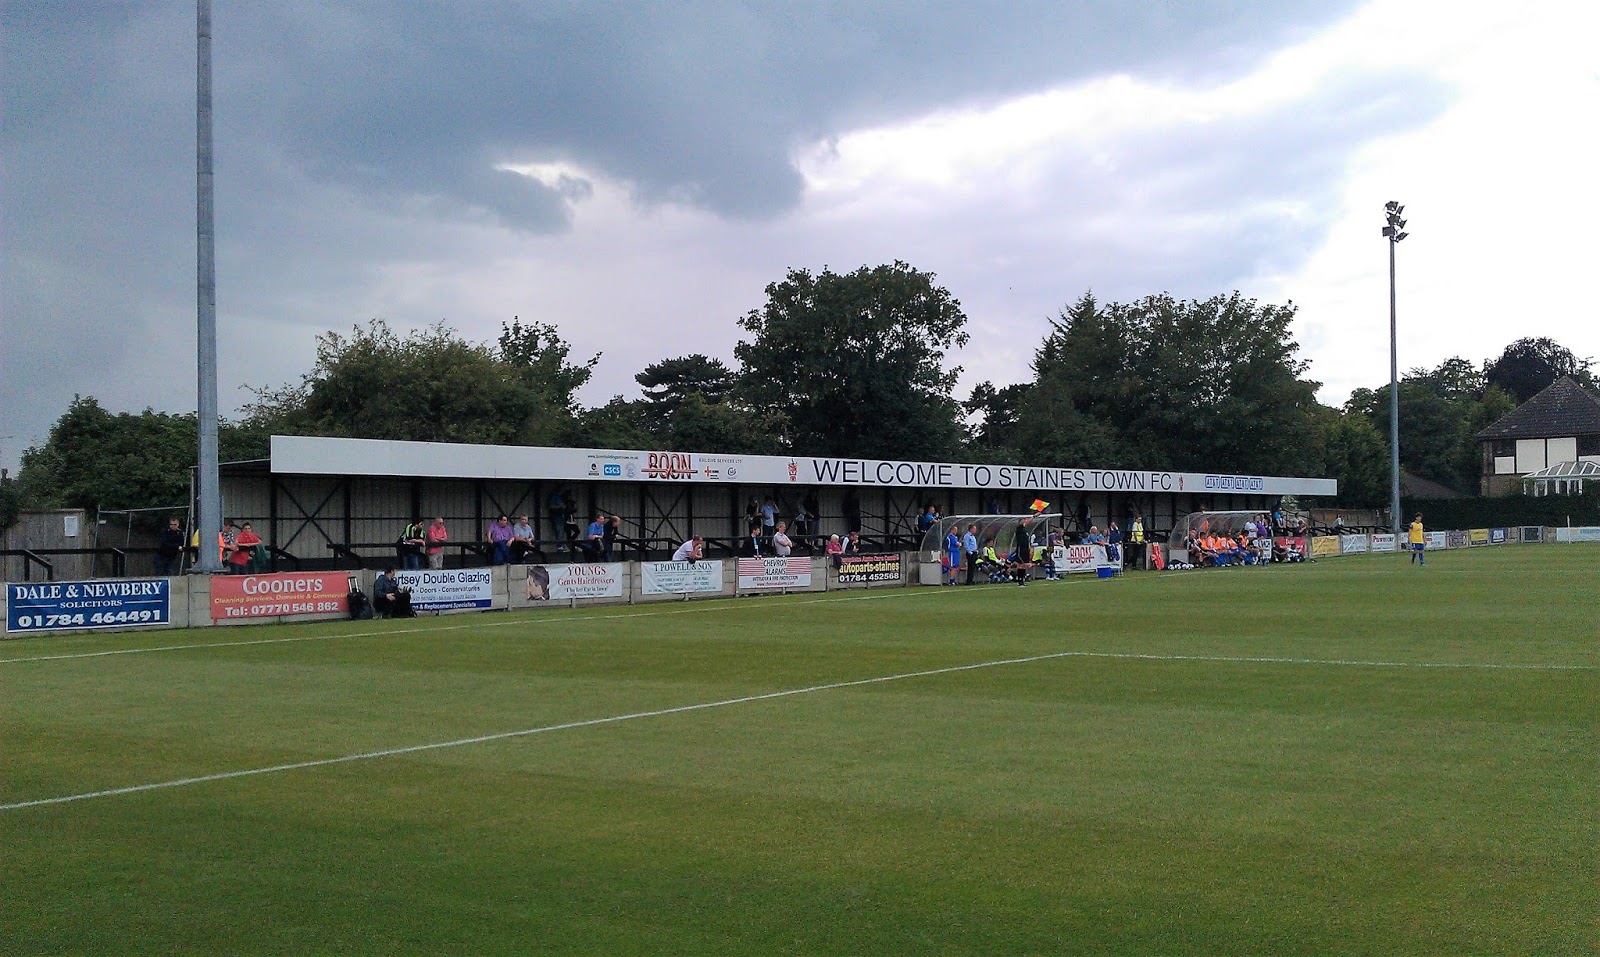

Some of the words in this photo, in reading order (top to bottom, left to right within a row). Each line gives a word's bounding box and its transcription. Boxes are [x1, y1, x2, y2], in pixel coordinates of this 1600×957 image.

[648, 453, 692, 479] BOON
[813, 460, 952, 484] WELCOME
[960, 466, 991, 486] TO
[999, 467, 1085, 488] STAINES
[1090, 471, 1145, 490] TOWN
[1151, 473, 1172, 490] FC
[568, 566, 606, 576] YOUNGS
[660, 563, 689, 571] POWELL
[839, 561, 900, 574] autoparts-staines
[424, 573, 456, 583] Double
[458, 572, 490, 584] Glazing
[16, 586, 61, 599] DALE
[66, 585, 78, 598] &
[83, 582, 162, 597] NEWBERY
[242, 577, 323, 594] Gooners
[60, 600, 122, 608] SOLICITORS
[225, 606, 248, 616] Tel:
[251, 604, 289, 614] 07770
[292, 603, 313, 612] 546
[318, 602, 338, 611] 862
[18, 614, 85, 627] 01784
[90, 610, 160, 624] 464491
